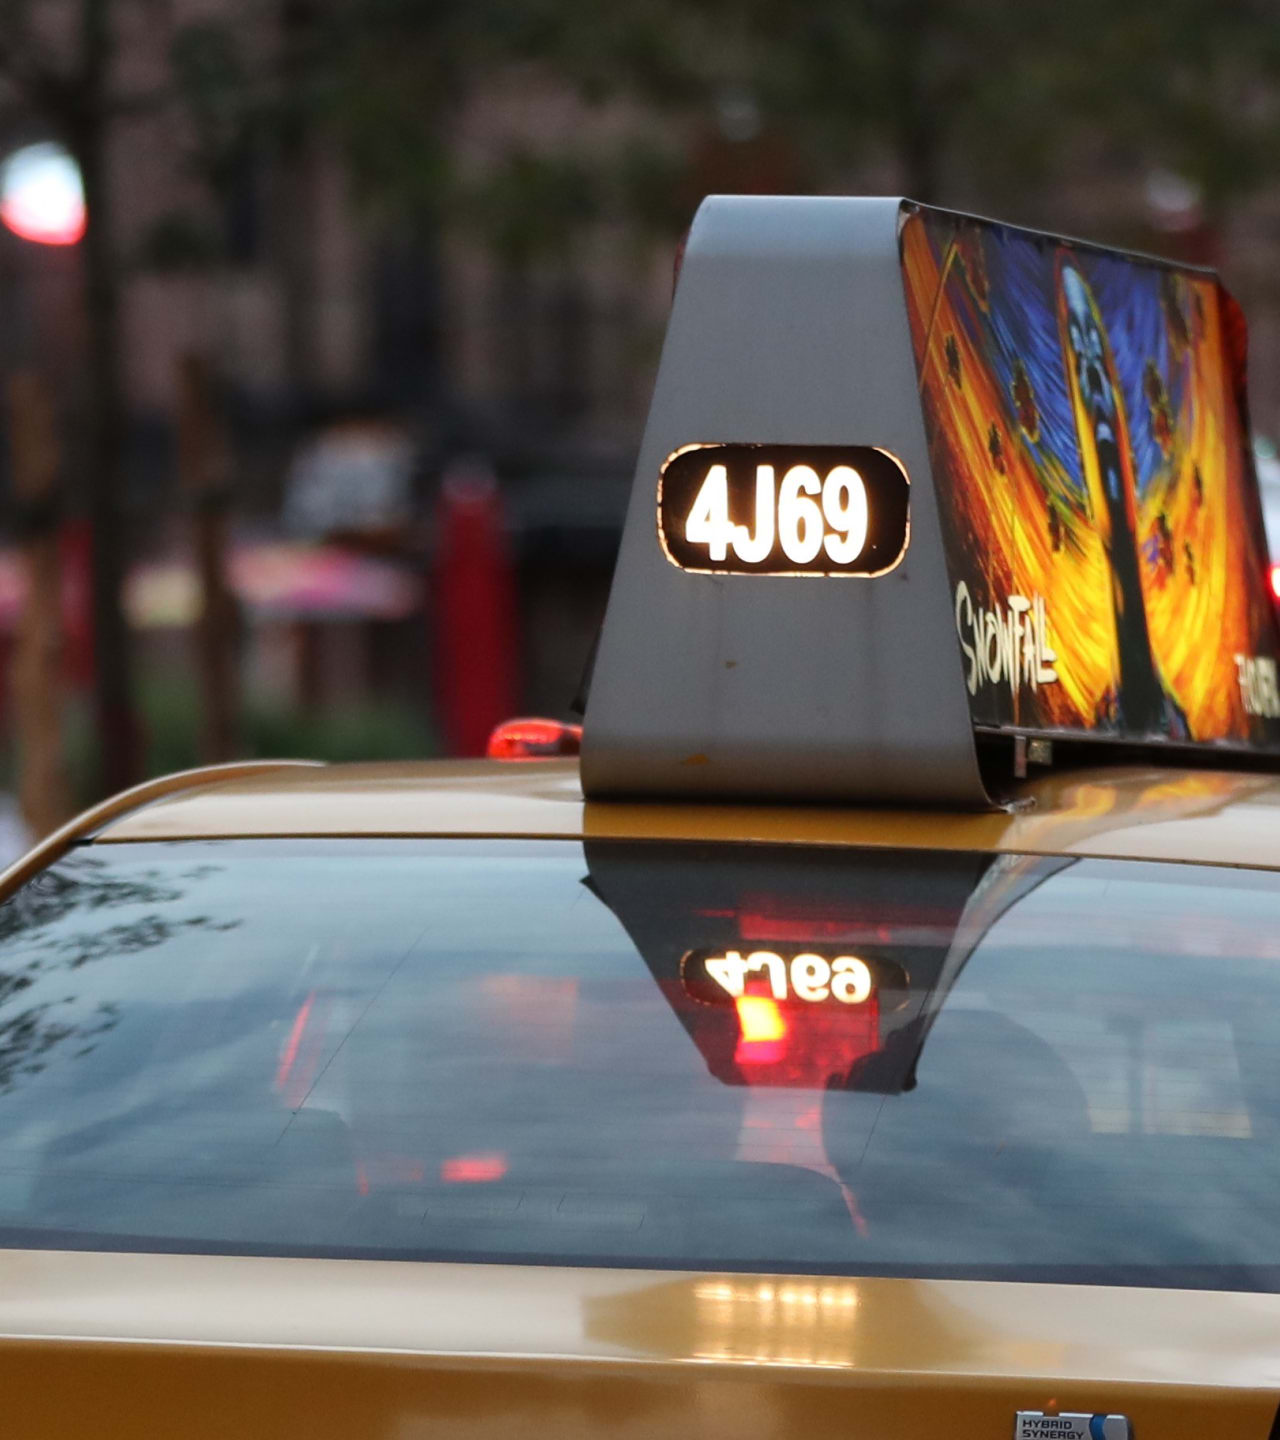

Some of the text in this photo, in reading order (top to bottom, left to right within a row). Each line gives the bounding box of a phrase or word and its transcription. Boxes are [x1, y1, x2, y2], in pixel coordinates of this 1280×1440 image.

[684, 464, 869, 565] 4J69
[1022, 1420, 1073, 1430] HYBRID
[1022, 1430, 1084, 1440] SYNERGY
